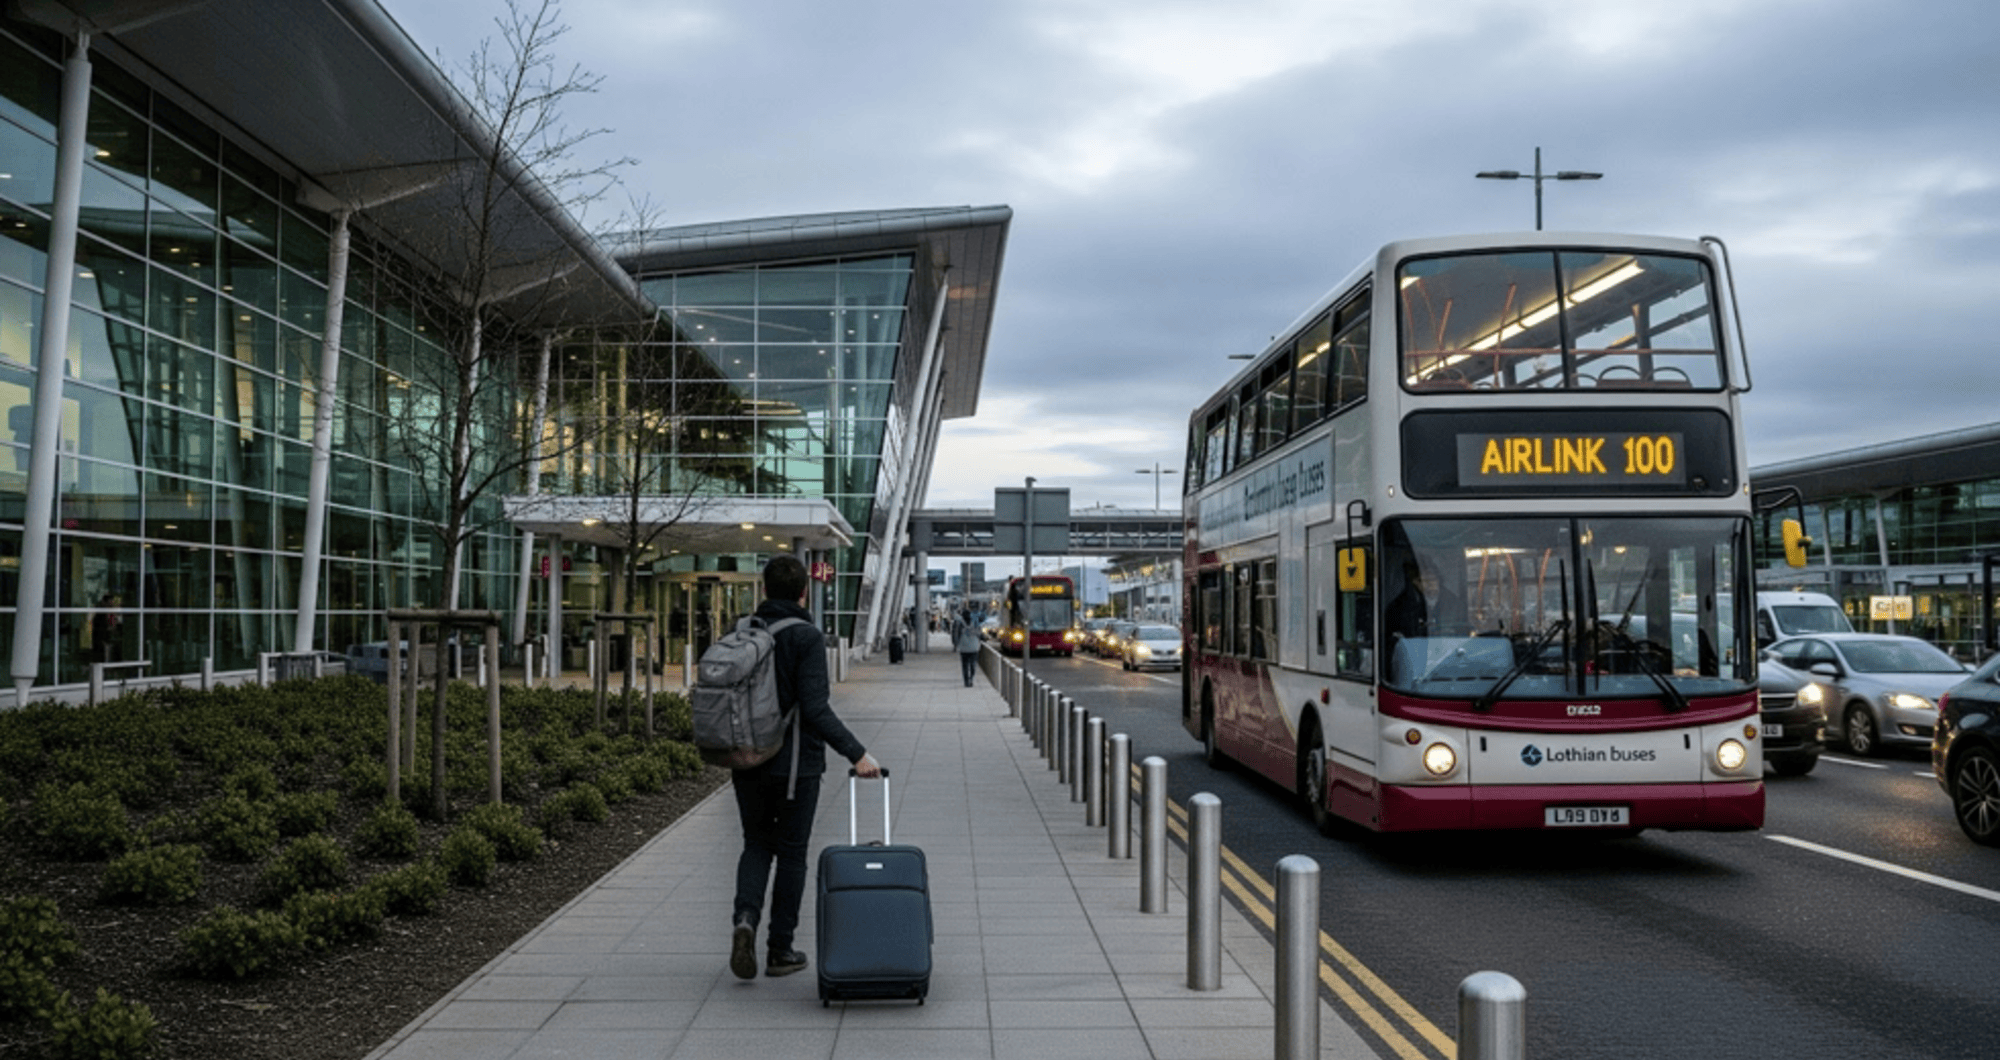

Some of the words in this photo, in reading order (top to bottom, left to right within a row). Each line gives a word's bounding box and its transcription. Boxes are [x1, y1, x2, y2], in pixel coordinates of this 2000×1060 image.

[1480, 437, 1608, 474] AIRLINK
[1622, 435, 1676, 475] 100
[1546, 746, 1607, 762] Lothian
[1610, 745, 1656, 762] buses
